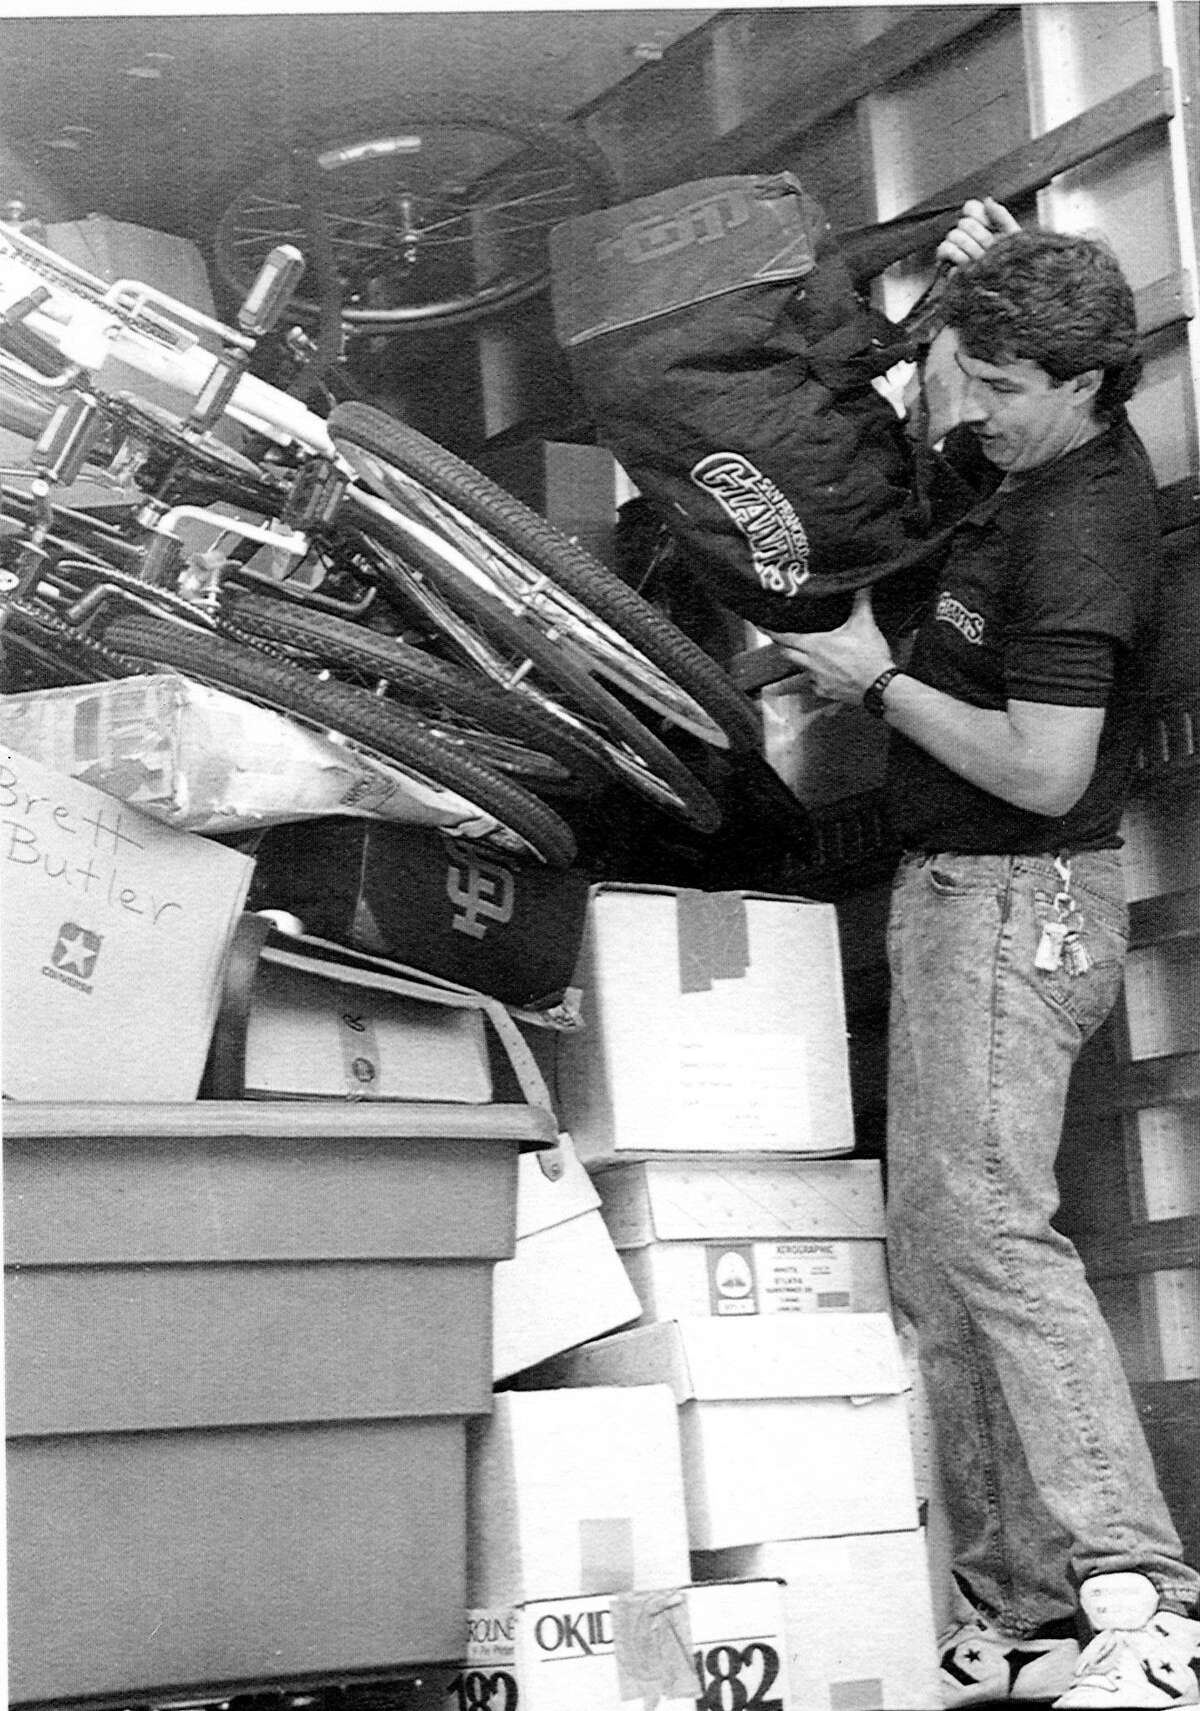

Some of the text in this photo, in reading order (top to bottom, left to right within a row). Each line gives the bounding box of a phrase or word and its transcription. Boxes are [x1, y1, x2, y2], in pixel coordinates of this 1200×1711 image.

[690, 451, 810, 597] GIANTS
[0, 764, 145, 855] Brett
[2, 820, 182, 925] Butler
